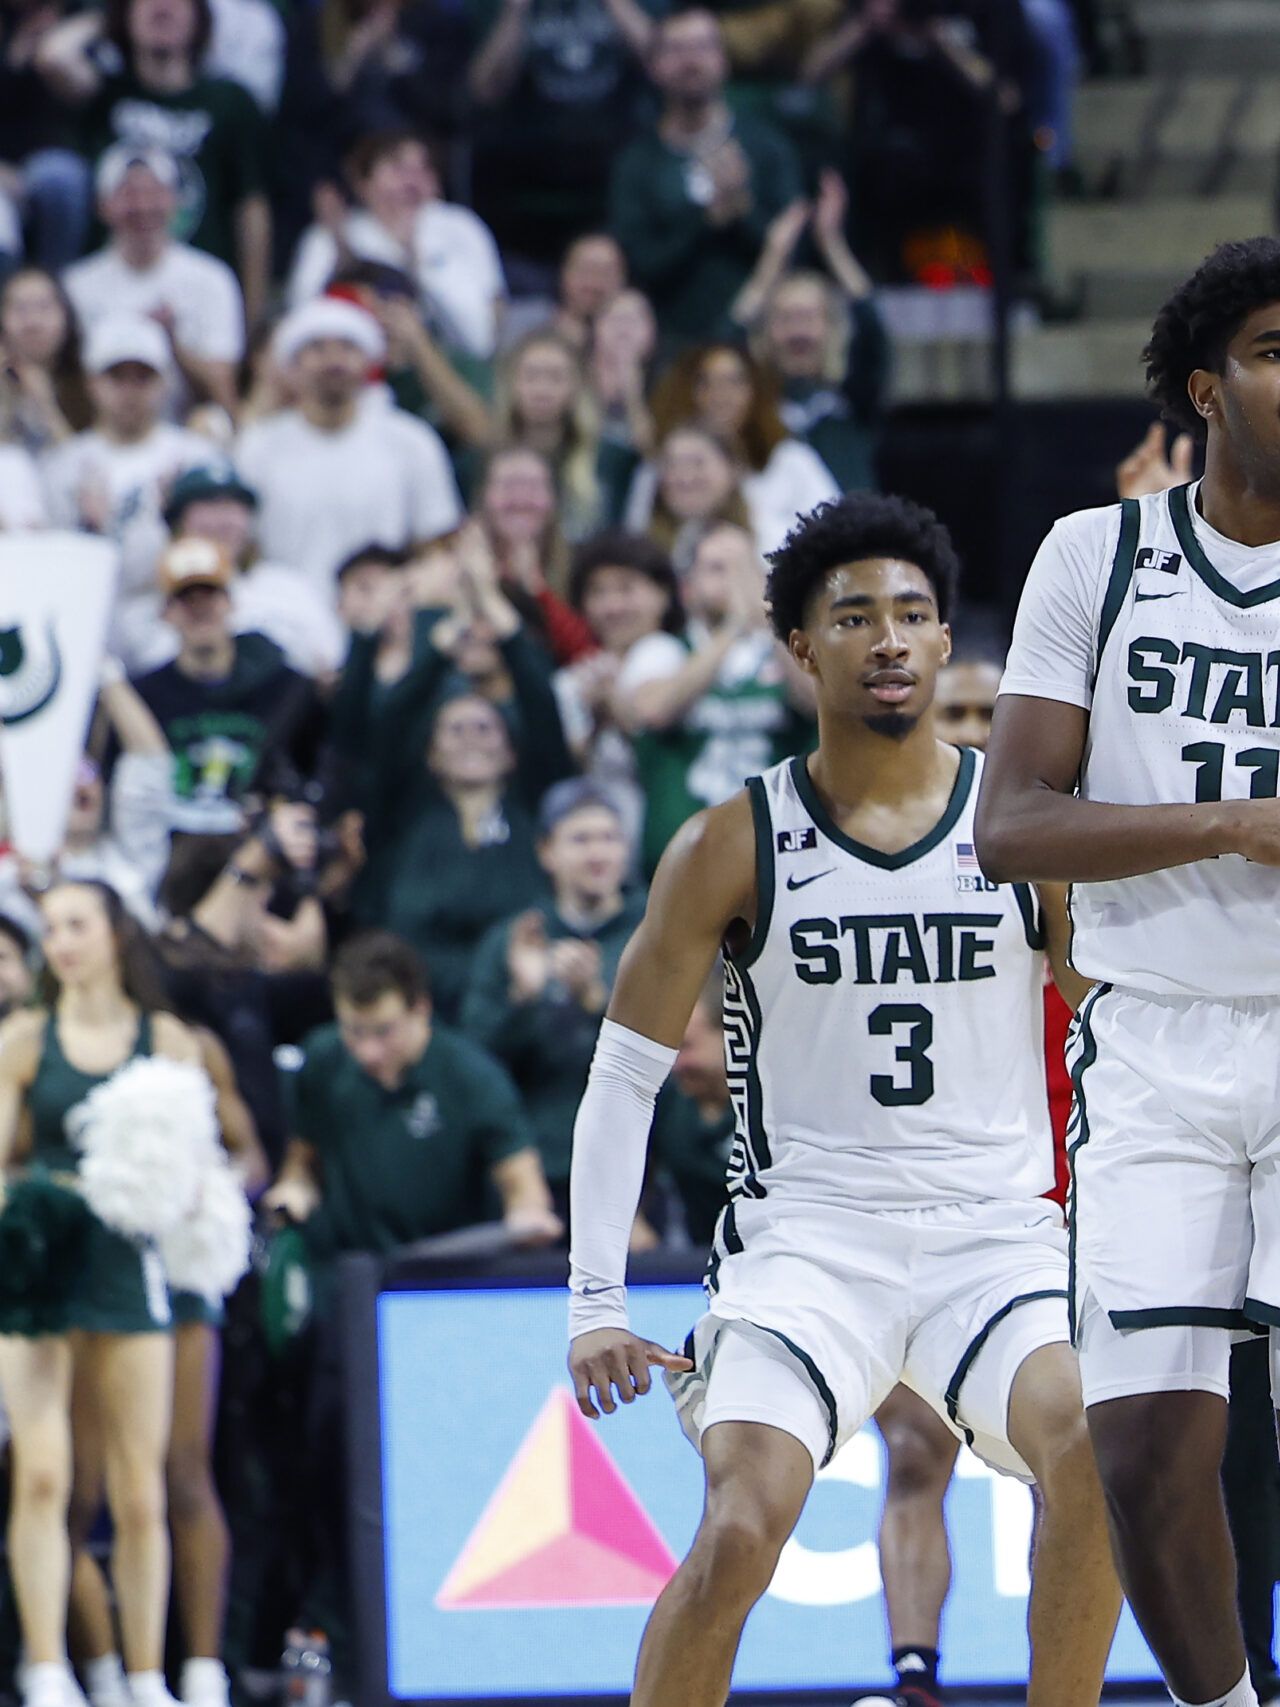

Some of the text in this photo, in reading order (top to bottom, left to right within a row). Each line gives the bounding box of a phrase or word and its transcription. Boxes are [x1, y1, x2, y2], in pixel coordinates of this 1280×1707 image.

[1143, 548, 1174, 570] JF
[1181, 741, 1280, 804] 11
[783, 829, 809, 851] JF
[790, 913, 1004, 985] STATE
[868, 1003, 935, 1107] 3
